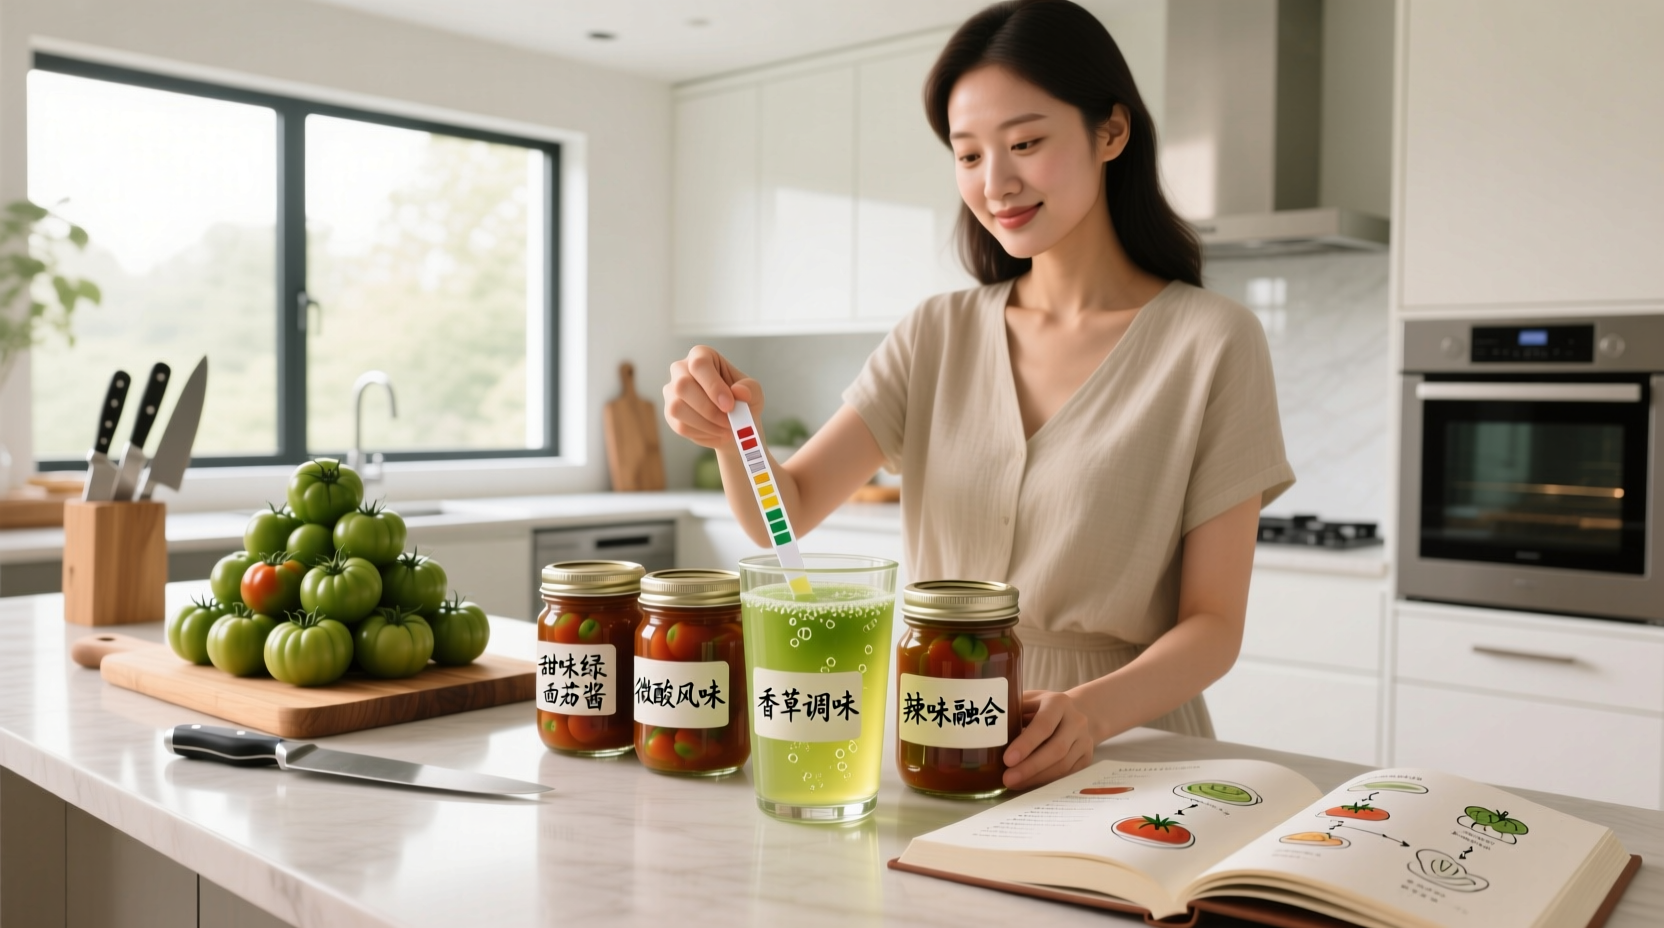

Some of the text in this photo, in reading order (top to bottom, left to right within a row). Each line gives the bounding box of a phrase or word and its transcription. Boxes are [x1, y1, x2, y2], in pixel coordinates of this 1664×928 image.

[538, 653, 608, 680] 甜味绿
[634, 676, 726, 710] 微酸风味
[757, 687, 860, 723] 香草调味
[903, 692, 1006, 728] 辣味融合
